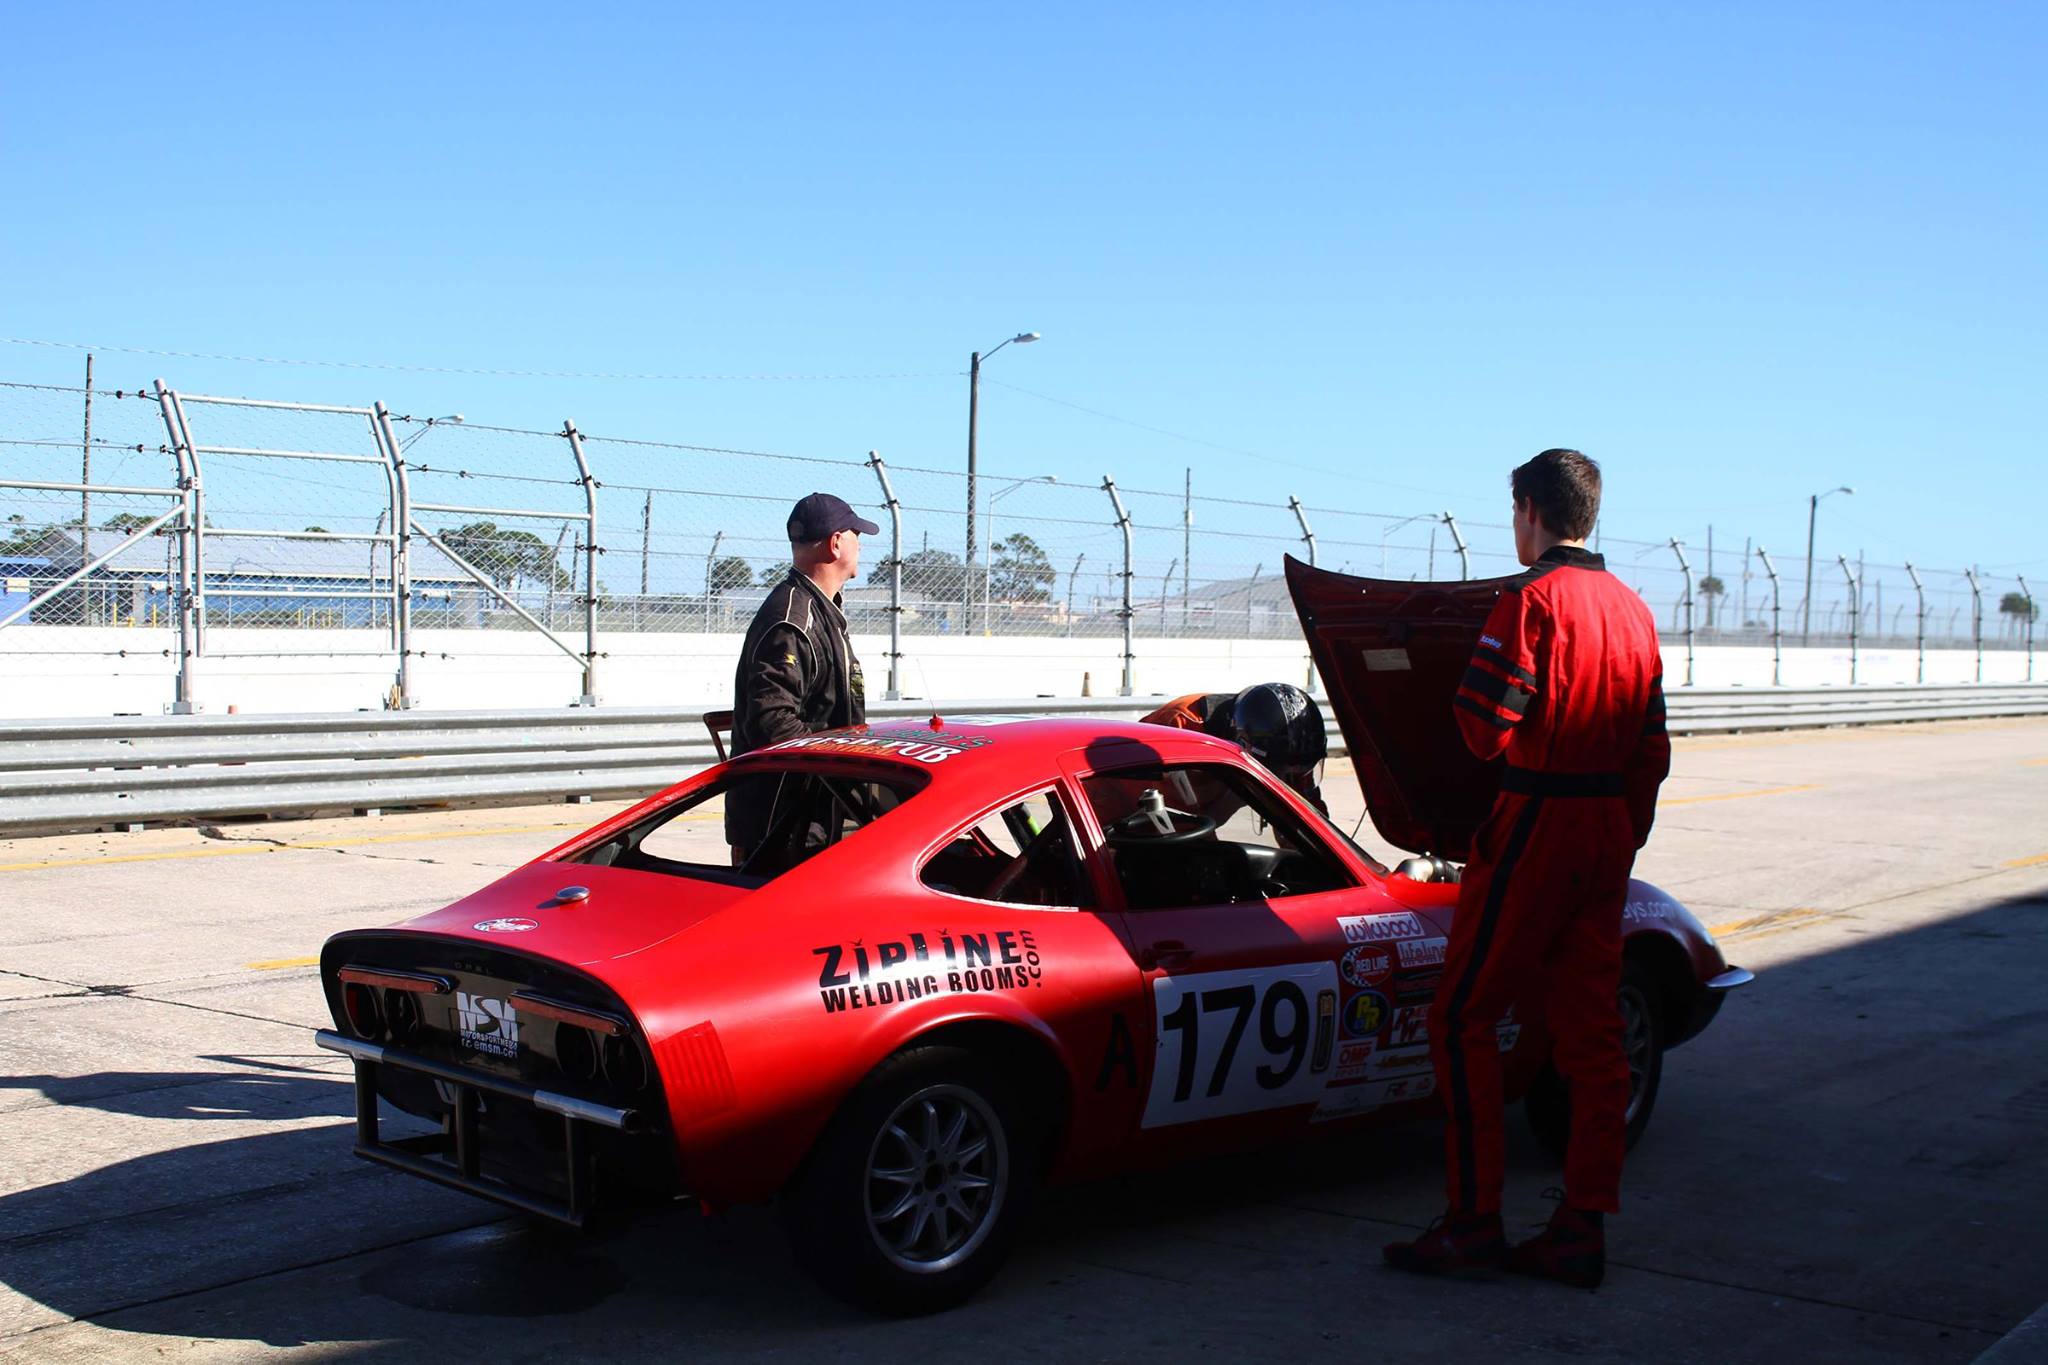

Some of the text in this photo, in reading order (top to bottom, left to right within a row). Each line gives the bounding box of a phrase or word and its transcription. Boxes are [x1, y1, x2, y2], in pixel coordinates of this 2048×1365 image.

[764, 737, 878, 751] IRISH
[882, 741, 961, 763] PUB
[1345, 912, 1420, 941] wilwood
[821, 974, 938, 1013] WELDING
[1095, 1012, 1138, 1093] A
[1163, 981, 1309, 1103] 179
